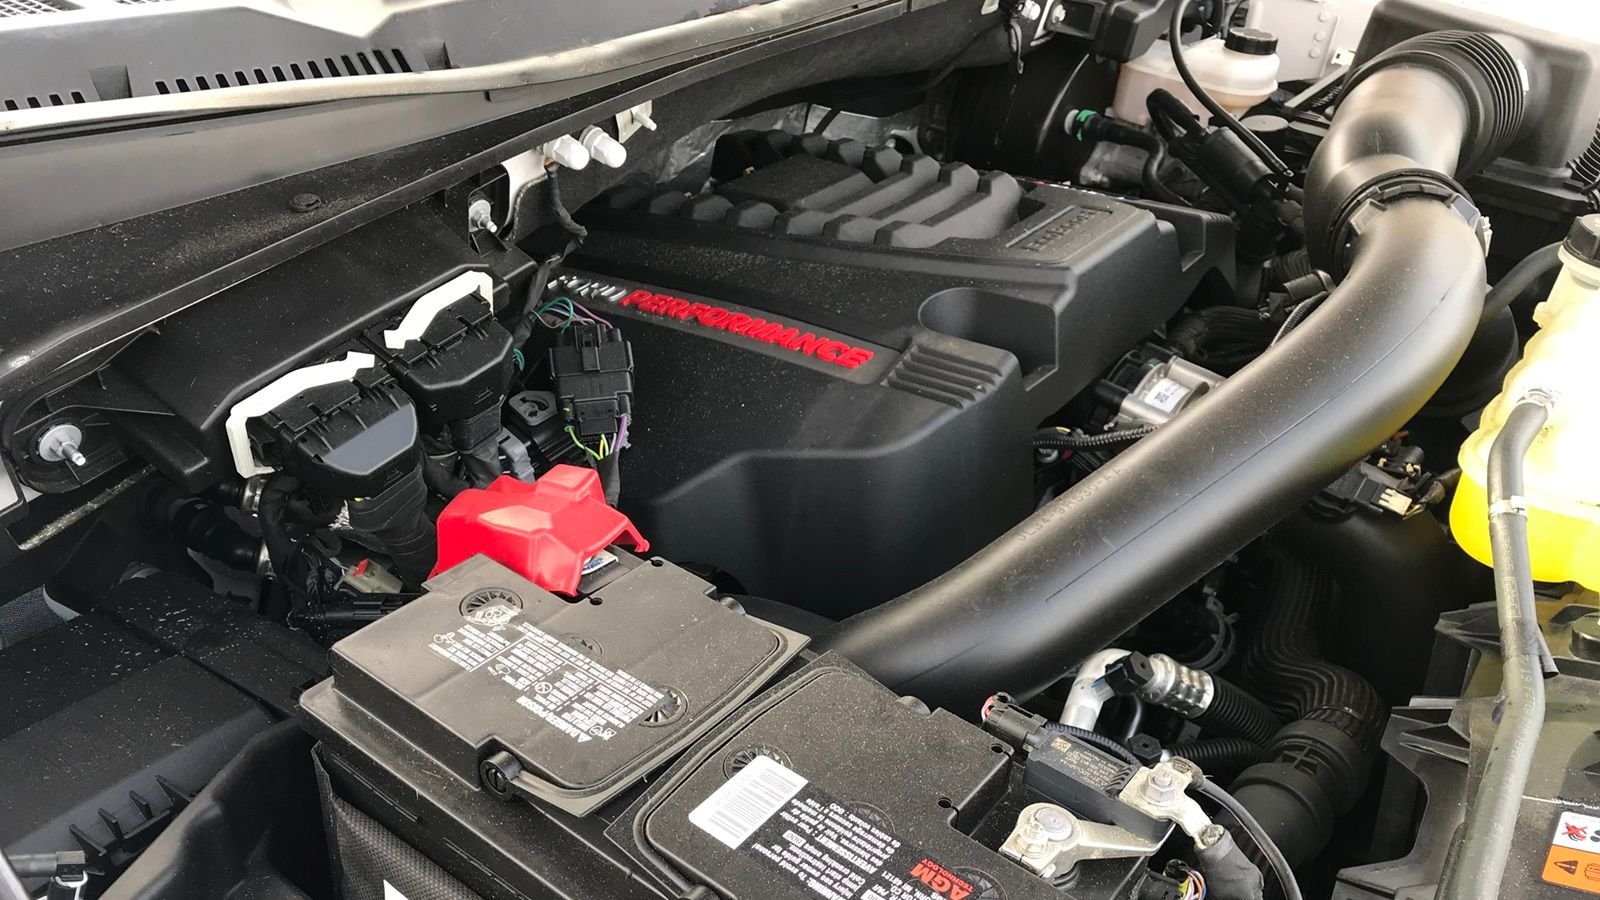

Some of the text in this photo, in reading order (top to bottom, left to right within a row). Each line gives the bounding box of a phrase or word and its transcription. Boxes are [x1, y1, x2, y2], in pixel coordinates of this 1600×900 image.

[620, 290, 874, 369] PERFORMANCE
[829, 803, 845, 814] 800
[799, 813, 819, 825] guide
[797, 822, 813, 834] Pour
[824, 829, 838, 840] Voir
[870, 827, 891, 842] cables
[753, 843, 782, 861] personal
[803, 843, 822, 857] amps
[815, 834, 876, 873] AVERTISSEMENT
[885, 846, 894, 854] de
[781, 850, 801, 864] guide
[870, 856, 883, 866] des
[780, 860, 799, 873] avoid
[799, 862, 820, 877] owner
[821, 854, 850, 874] cranking
[820, 875, 833, 885] see
[825, 868, 842, 880] start
[848, 872, 865, 885] Cold
[881, 871, 902, 886] 48121
[921, 859, 972, 892] TECHNOLOGY
[841, 877, 861, 891] jump
[912, 863, 968, 900] AGM
[872, 884, 889, 896] PAR
[890, 884, 902, 895] CO.
